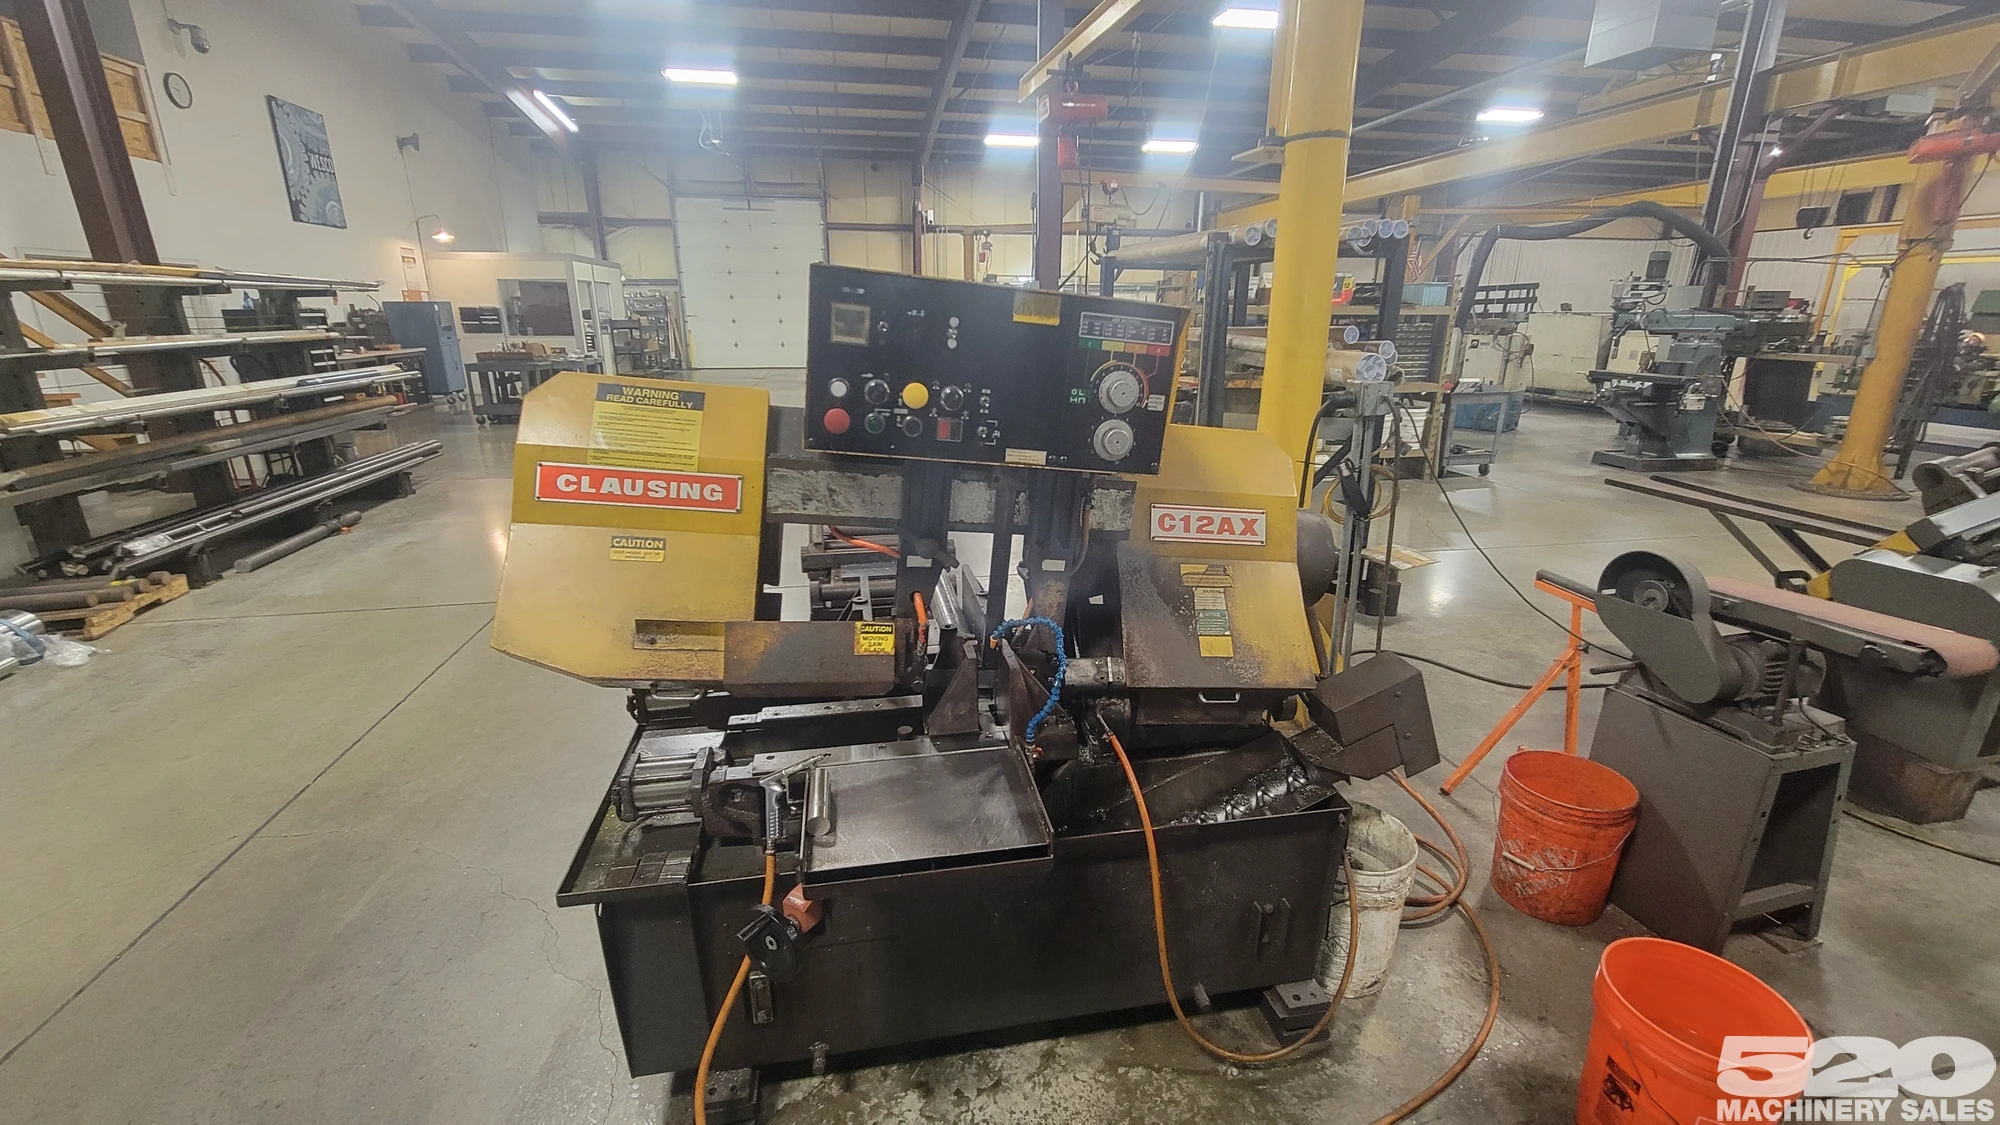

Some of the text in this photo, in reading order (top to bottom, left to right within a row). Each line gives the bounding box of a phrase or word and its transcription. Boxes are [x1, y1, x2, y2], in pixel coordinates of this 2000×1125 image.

[308, 152, 334, 173] WESCO
[606, 393, 694, 409] READ CAREFULLY
[622, 386, 680, 401] WARNING
[556, 474, 723, 501] CLAUSING
[1157, 513, 1259, 537] C12AX
[612, 538, 664, 549] CAUTION
